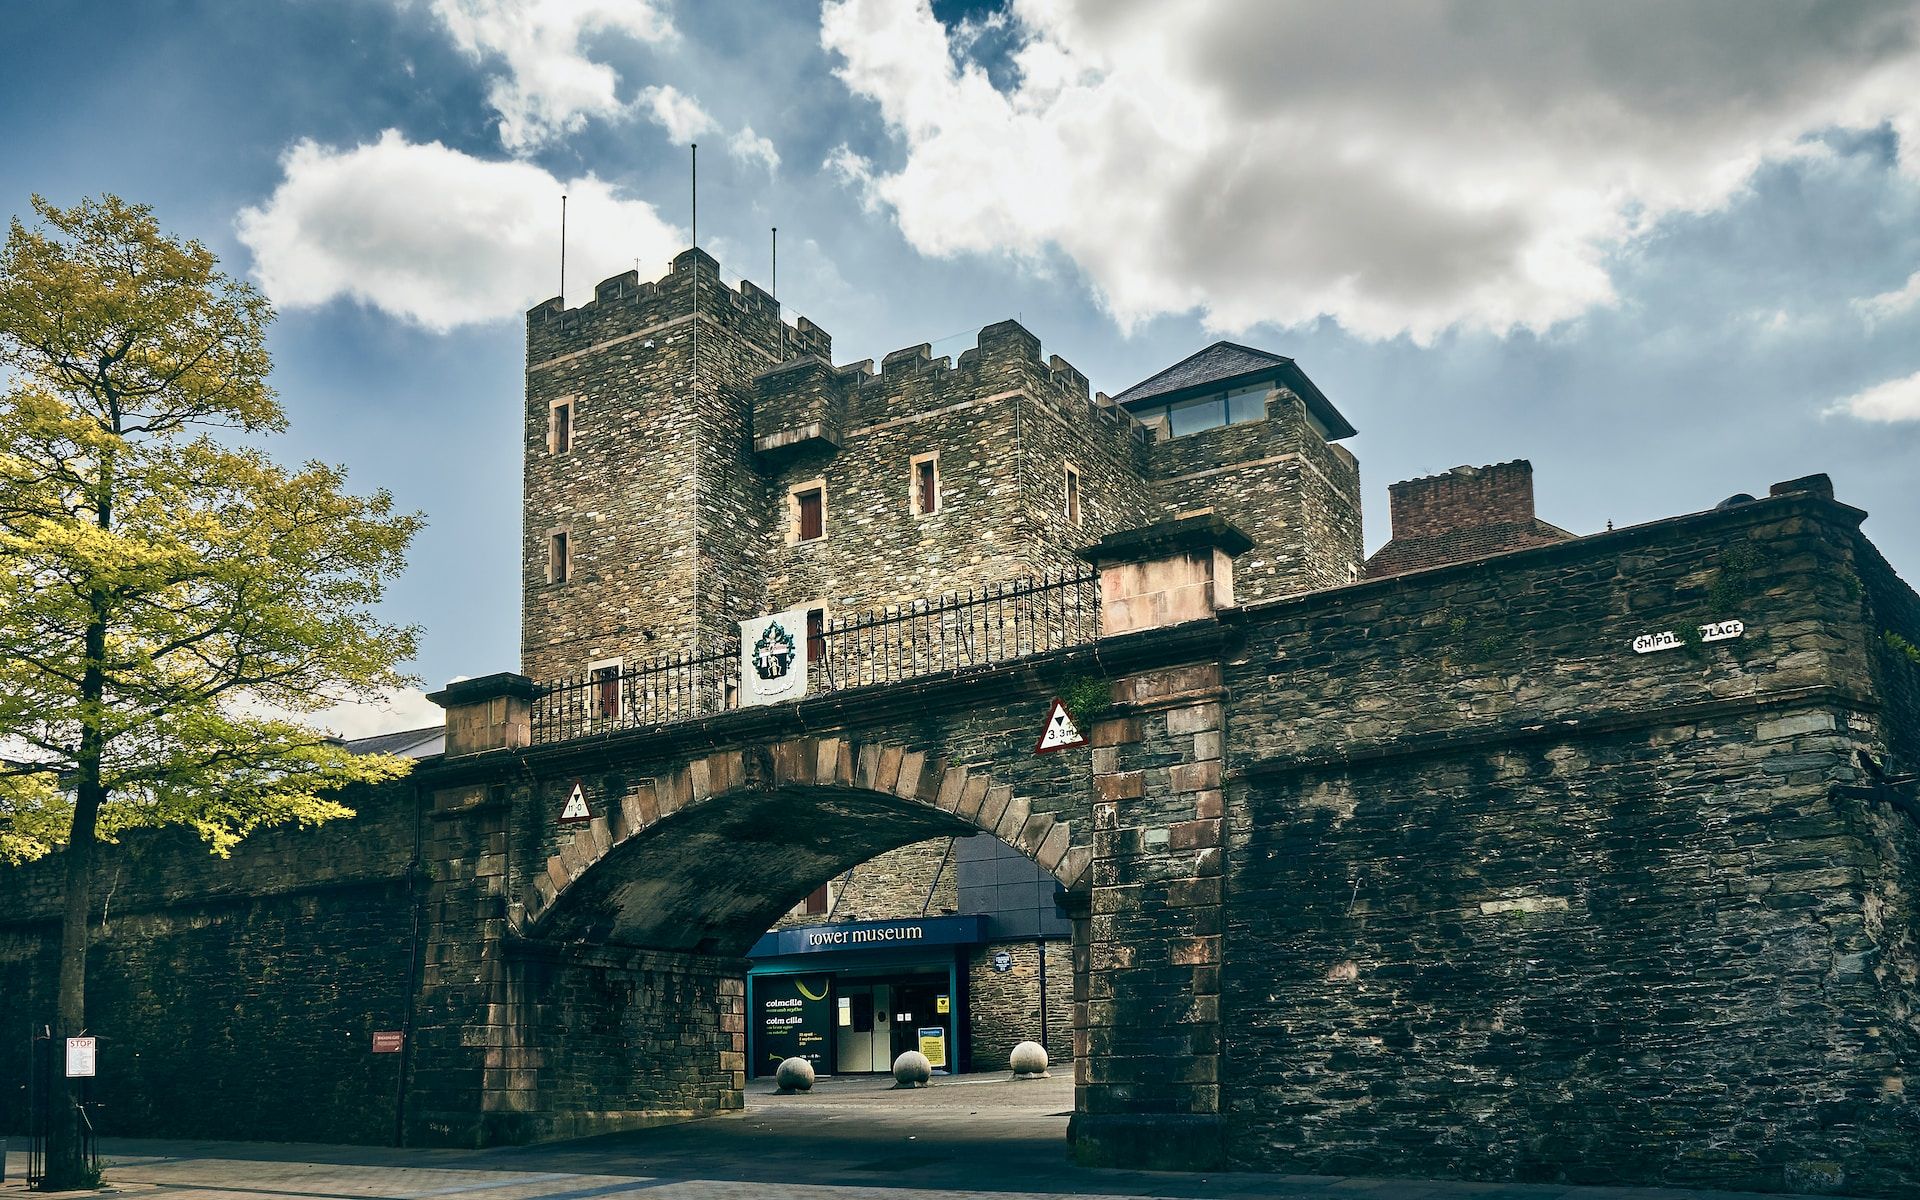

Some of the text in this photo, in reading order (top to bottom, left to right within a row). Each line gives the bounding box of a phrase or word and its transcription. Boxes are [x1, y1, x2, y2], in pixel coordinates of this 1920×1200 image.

[1700, 623, 1741, 640] PLACE
[809, 926, 923, 946] tower museum
[70, 1040, 92, 1048] STOP
